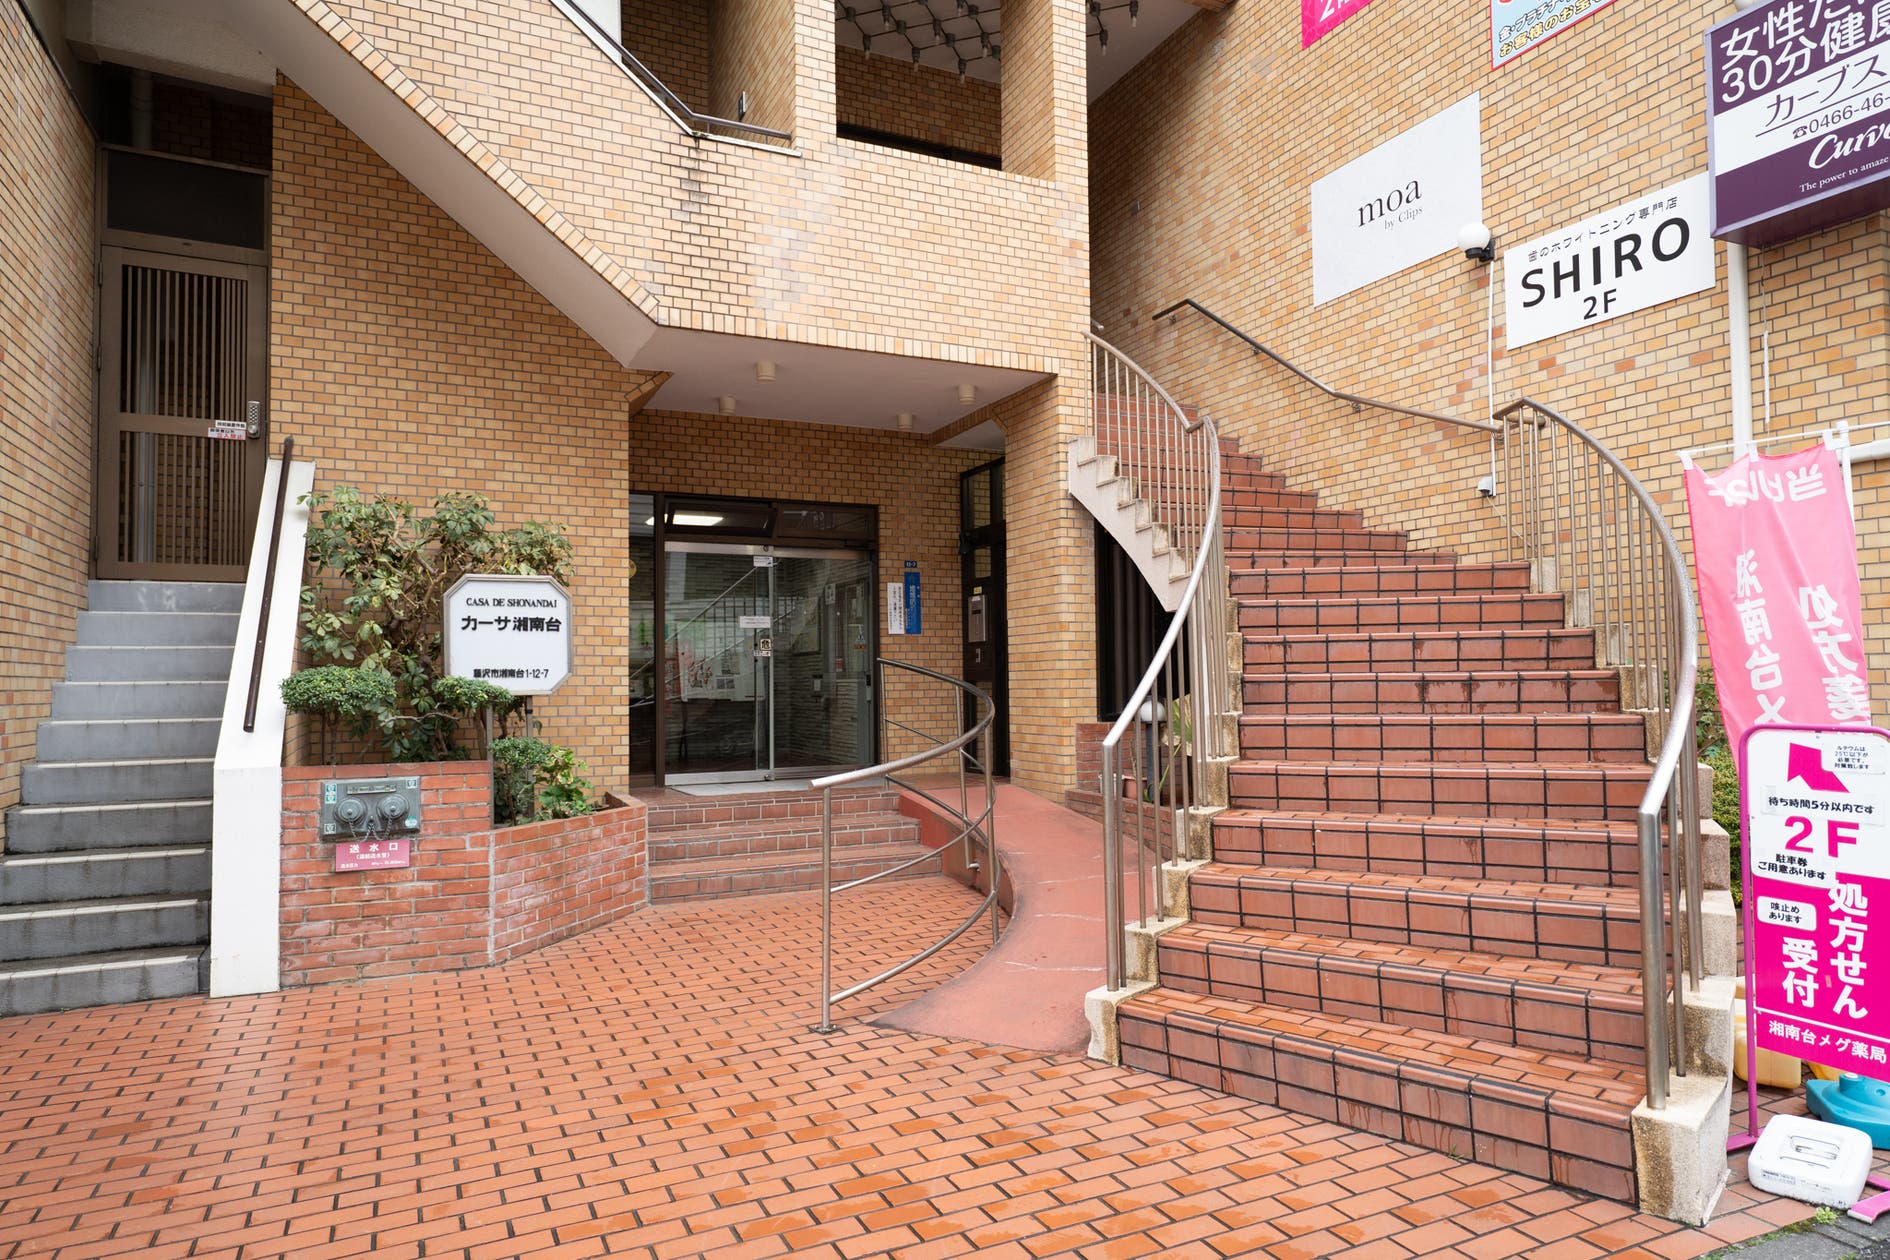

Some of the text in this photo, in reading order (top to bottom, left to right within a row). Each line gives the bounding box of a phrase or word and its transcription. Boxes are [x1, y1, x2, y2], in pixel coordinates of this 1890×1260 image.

[1499, 0, 1603, 57] お客様のお宝
[1765, 54, 1887, 127] カーブス
[1799, 156, 1889, 192] The power to amaze
[1358, 180, 1422, 227] moa
[1385, 208, 1422, 230] by Clips
[1528, 197, 1677, 262] 歯のホワイトニング専門店
[1521, 217, 1690, 308] SHIRO
[1583, 288, 1617, 320] 2F
[466, 598, 557, 608] CASA DE SHONANDAI
[461, 615, 562, 632] カーサ湘南台
[1768, 796, 1875, 814] 待ち時間5分以内です
[349, 842, 398, 853] 送水口
[1784, 815, 1859, 858] 2F
[1758, 861, 1826, 880] ご用意あります
[1776, 854, 1807, 867] 駐車券
[1768, 912, 1802, 924] あります
[1770, 902, 1800, 914] 咳止め
[1828, 879, 1868, 1019] 処方せん
[1782, 936, 1820, 1008] 受付
[1768, 1020, 1887, 1064] 湘南台メグ薬局
